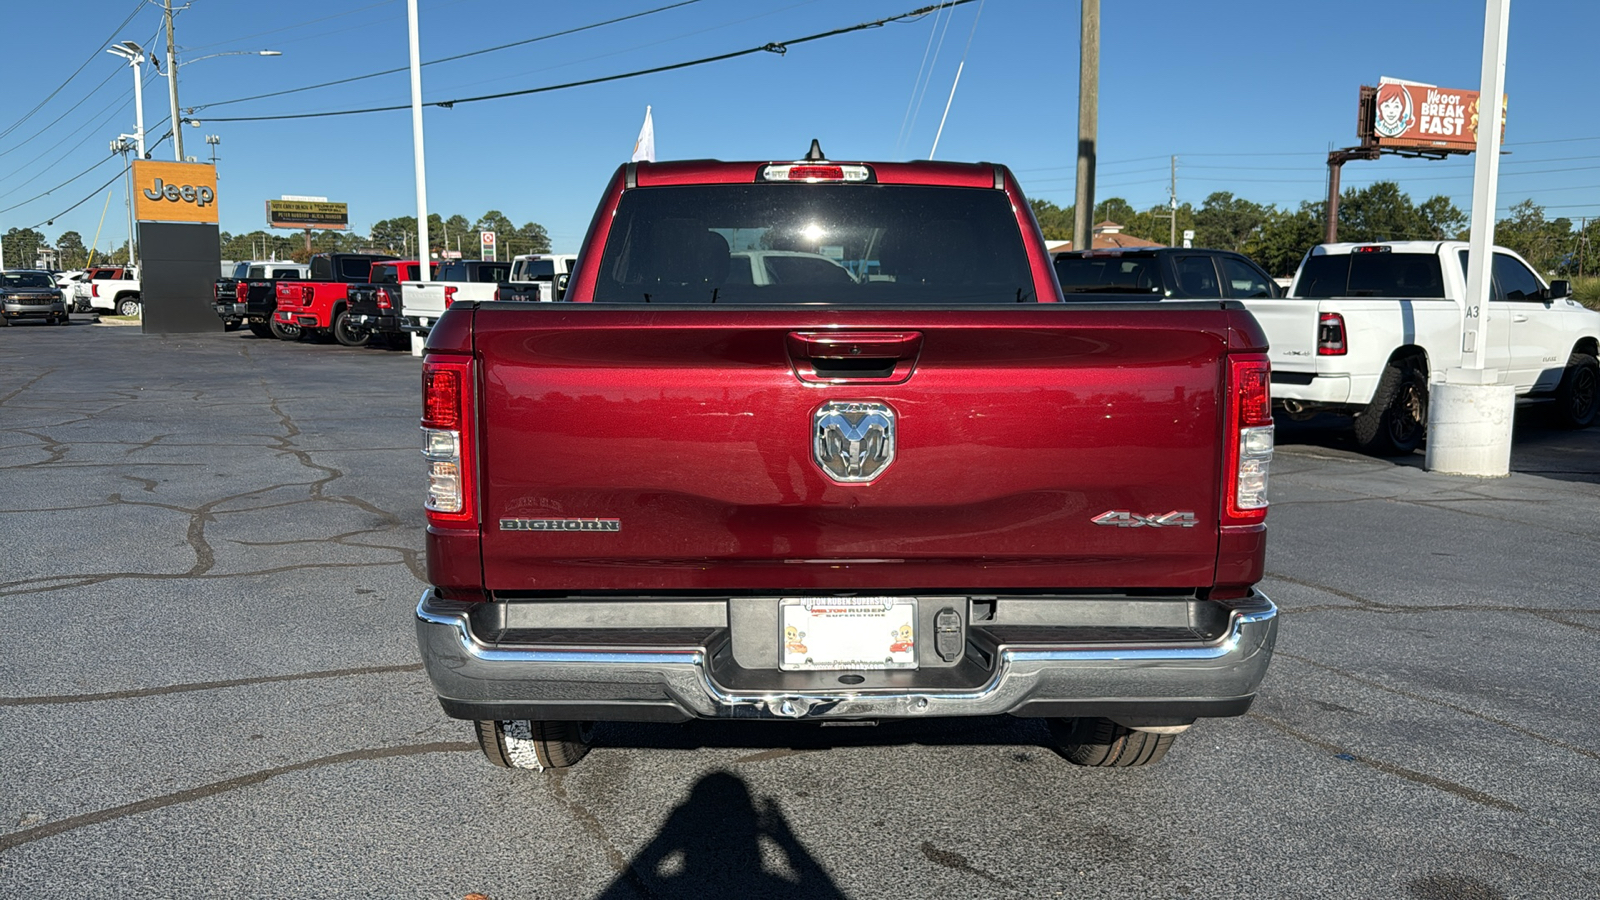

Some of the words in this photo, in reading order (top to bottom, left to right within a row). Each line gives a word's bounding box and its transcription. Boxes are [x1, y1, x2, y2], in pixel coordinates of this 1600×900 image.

[1427, 89, 1440, 105] We
[1440, 94, 1461, 105] GOT
[1421, 102, 1465, 118] BREAK
[1420, 115, 1465, 136] FAST
[143, 177, 214, 207] Jeep
[1466, 305, 1480, 318] A3
[499, 518, 620, 532] BIGHORN
